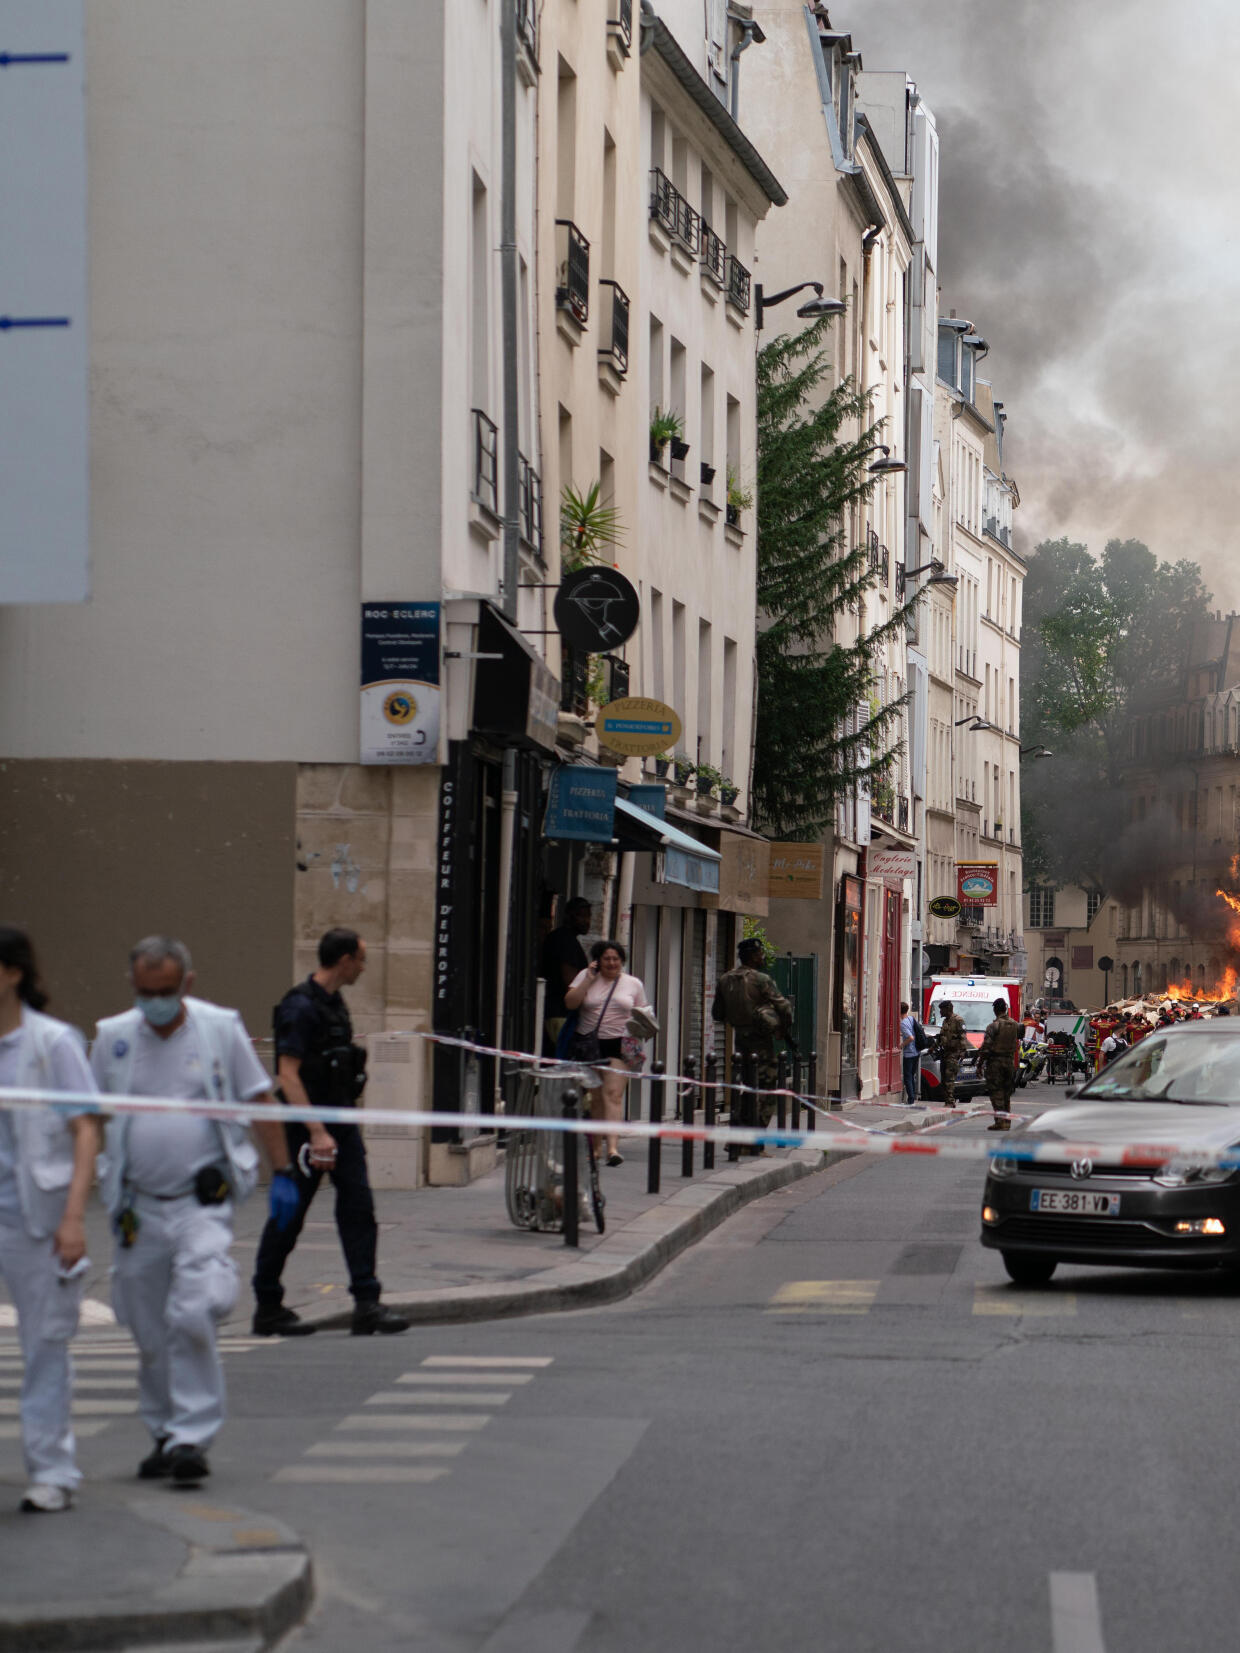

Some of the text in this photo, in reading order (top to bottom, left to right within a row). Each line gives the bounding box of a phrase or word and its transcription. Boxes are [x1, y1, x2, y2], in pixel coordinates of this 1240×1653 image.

[364, 609, 388, 619] ROC
[614, 700, 665, 716] PIZZERIA
[610, 737, 668, 753] TRATTORIA
[570, 786, 606, 798] PIZZERIA
[563, 808, 609, 821] TRATTORIA
[440, 781, 453, 889] COIFFEUR
[873, 852, 912, 864] Onglerie
[870, 865, 914, 877] Modelage
[438, 904, 453, 999] D'EUROPE
